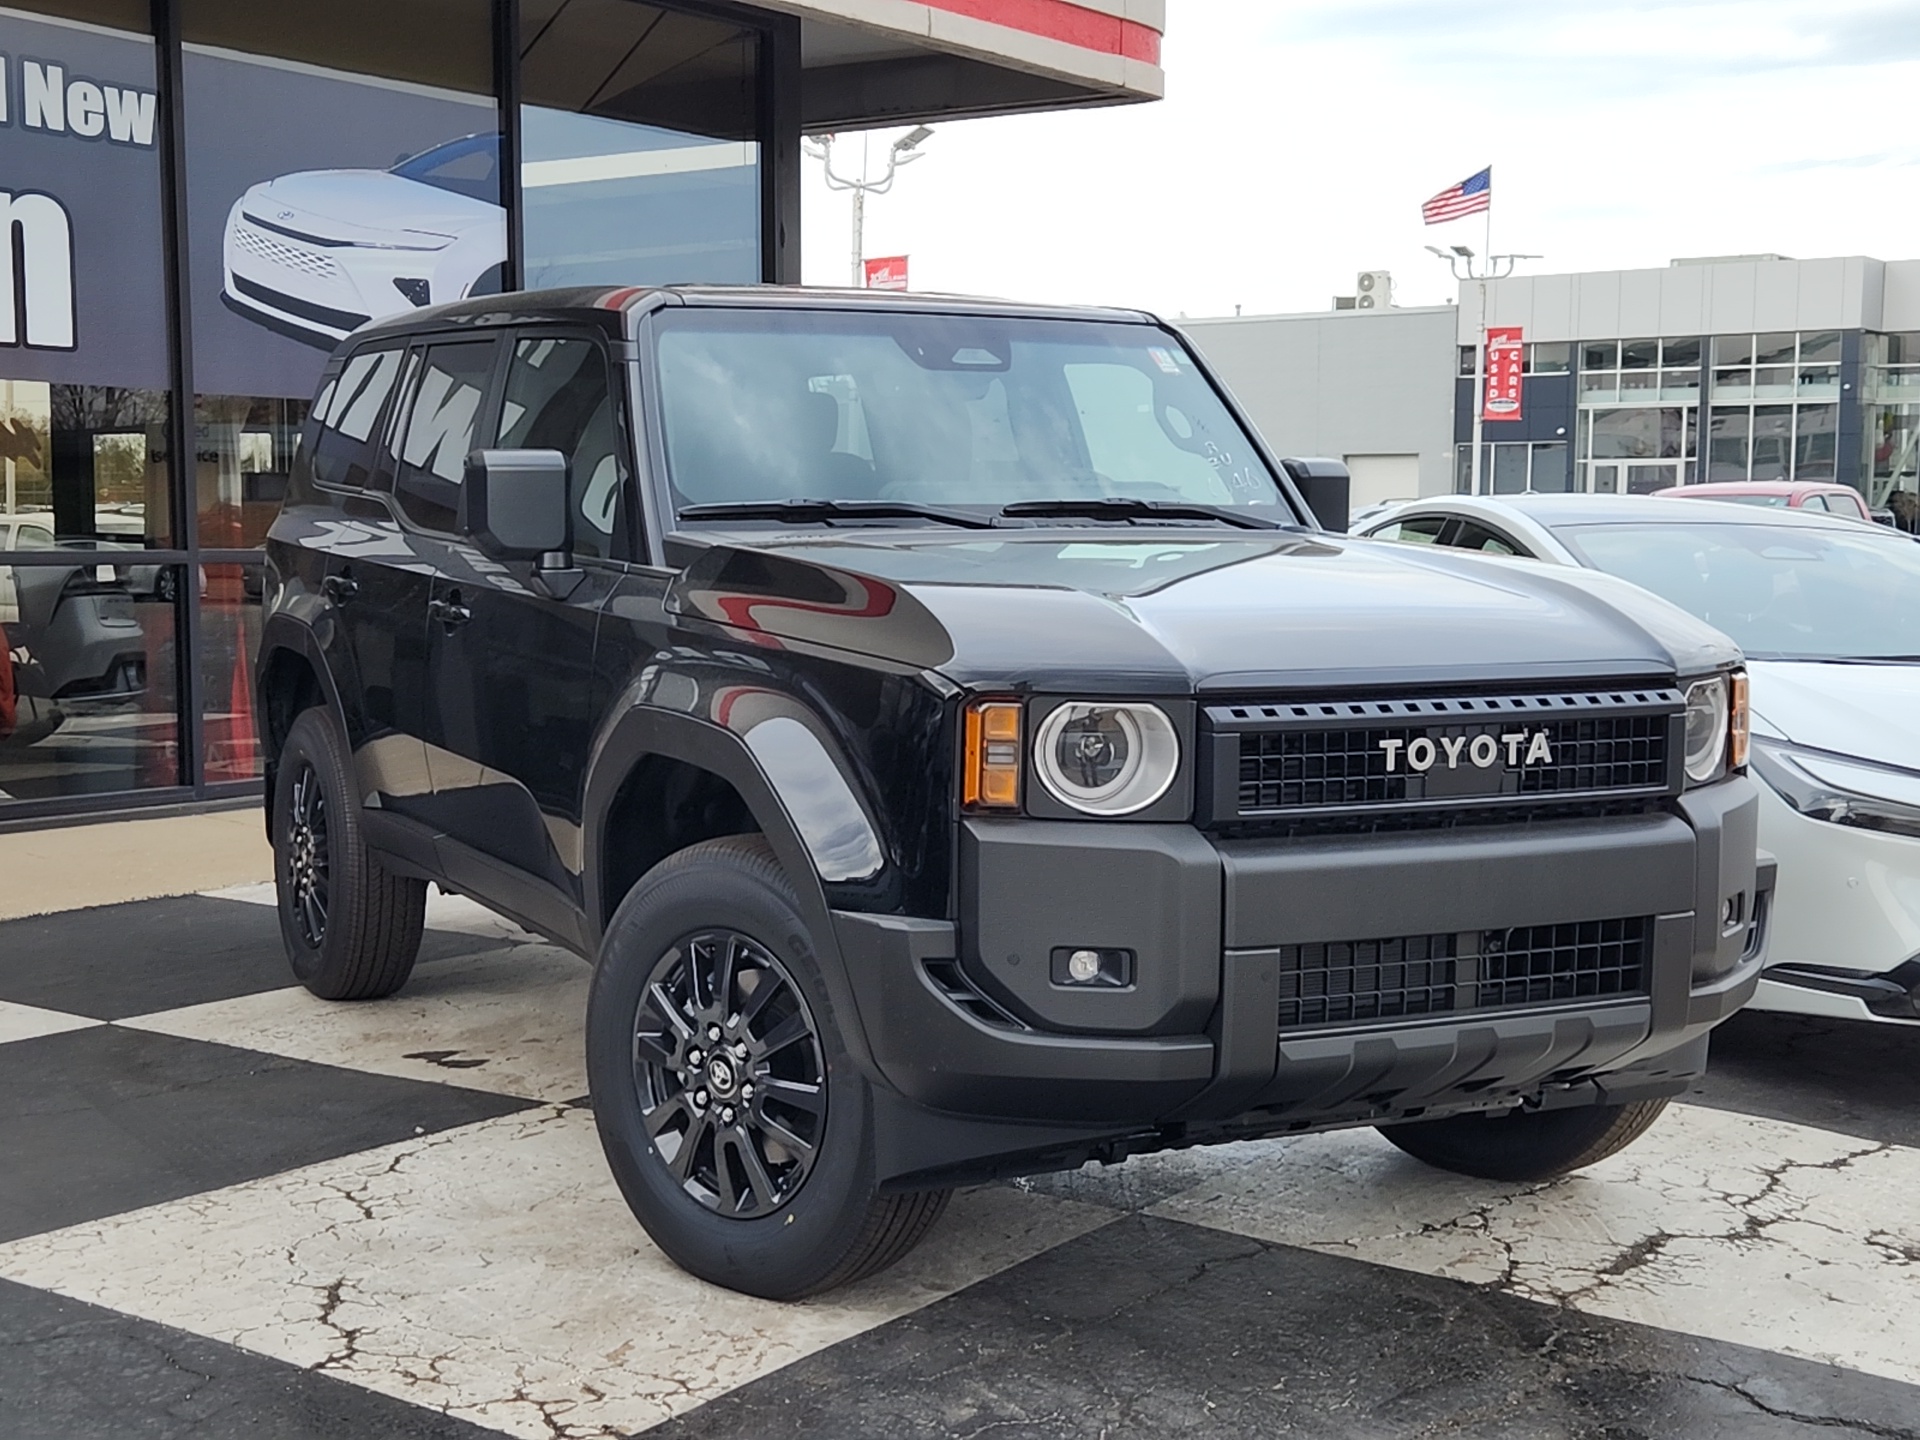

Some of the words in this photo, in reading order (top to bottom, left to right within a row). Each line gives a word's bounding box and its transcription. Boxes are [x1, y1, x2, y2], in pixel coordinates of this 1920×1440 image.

[24, 61, 156, 145] New
[1488, 350, 1500, 398] USED
[1507, 350, 1519, 398] CARS
[1379, 733, 1552, 772] TOYOTA
